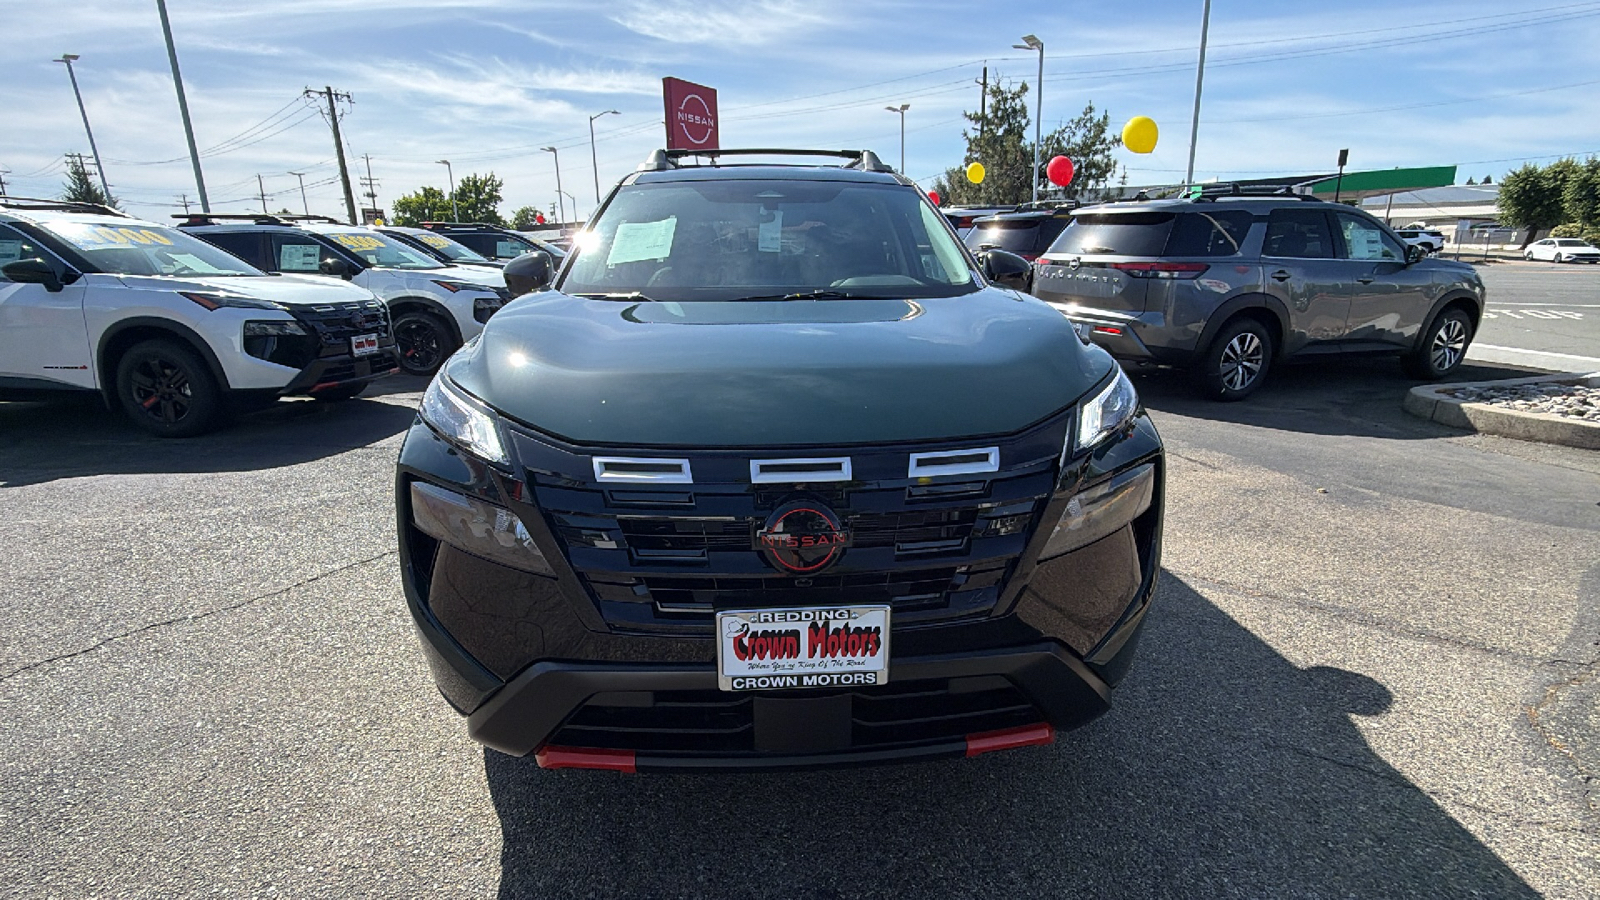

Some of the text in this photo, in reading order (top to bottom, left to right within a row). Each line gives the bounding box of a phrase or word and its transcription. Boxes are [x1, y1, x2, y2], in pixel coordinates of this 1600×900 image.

[677, 111, 714, 127] NISSAN
[760, 533, 846, 547] NISSAN
[760, 610, 849, 622] REDDING
[733, 622, 881, 661] Crown Motors
[831, 658, 844, 667] The
[732, 672, 876, 689] CROWN MOTORS
